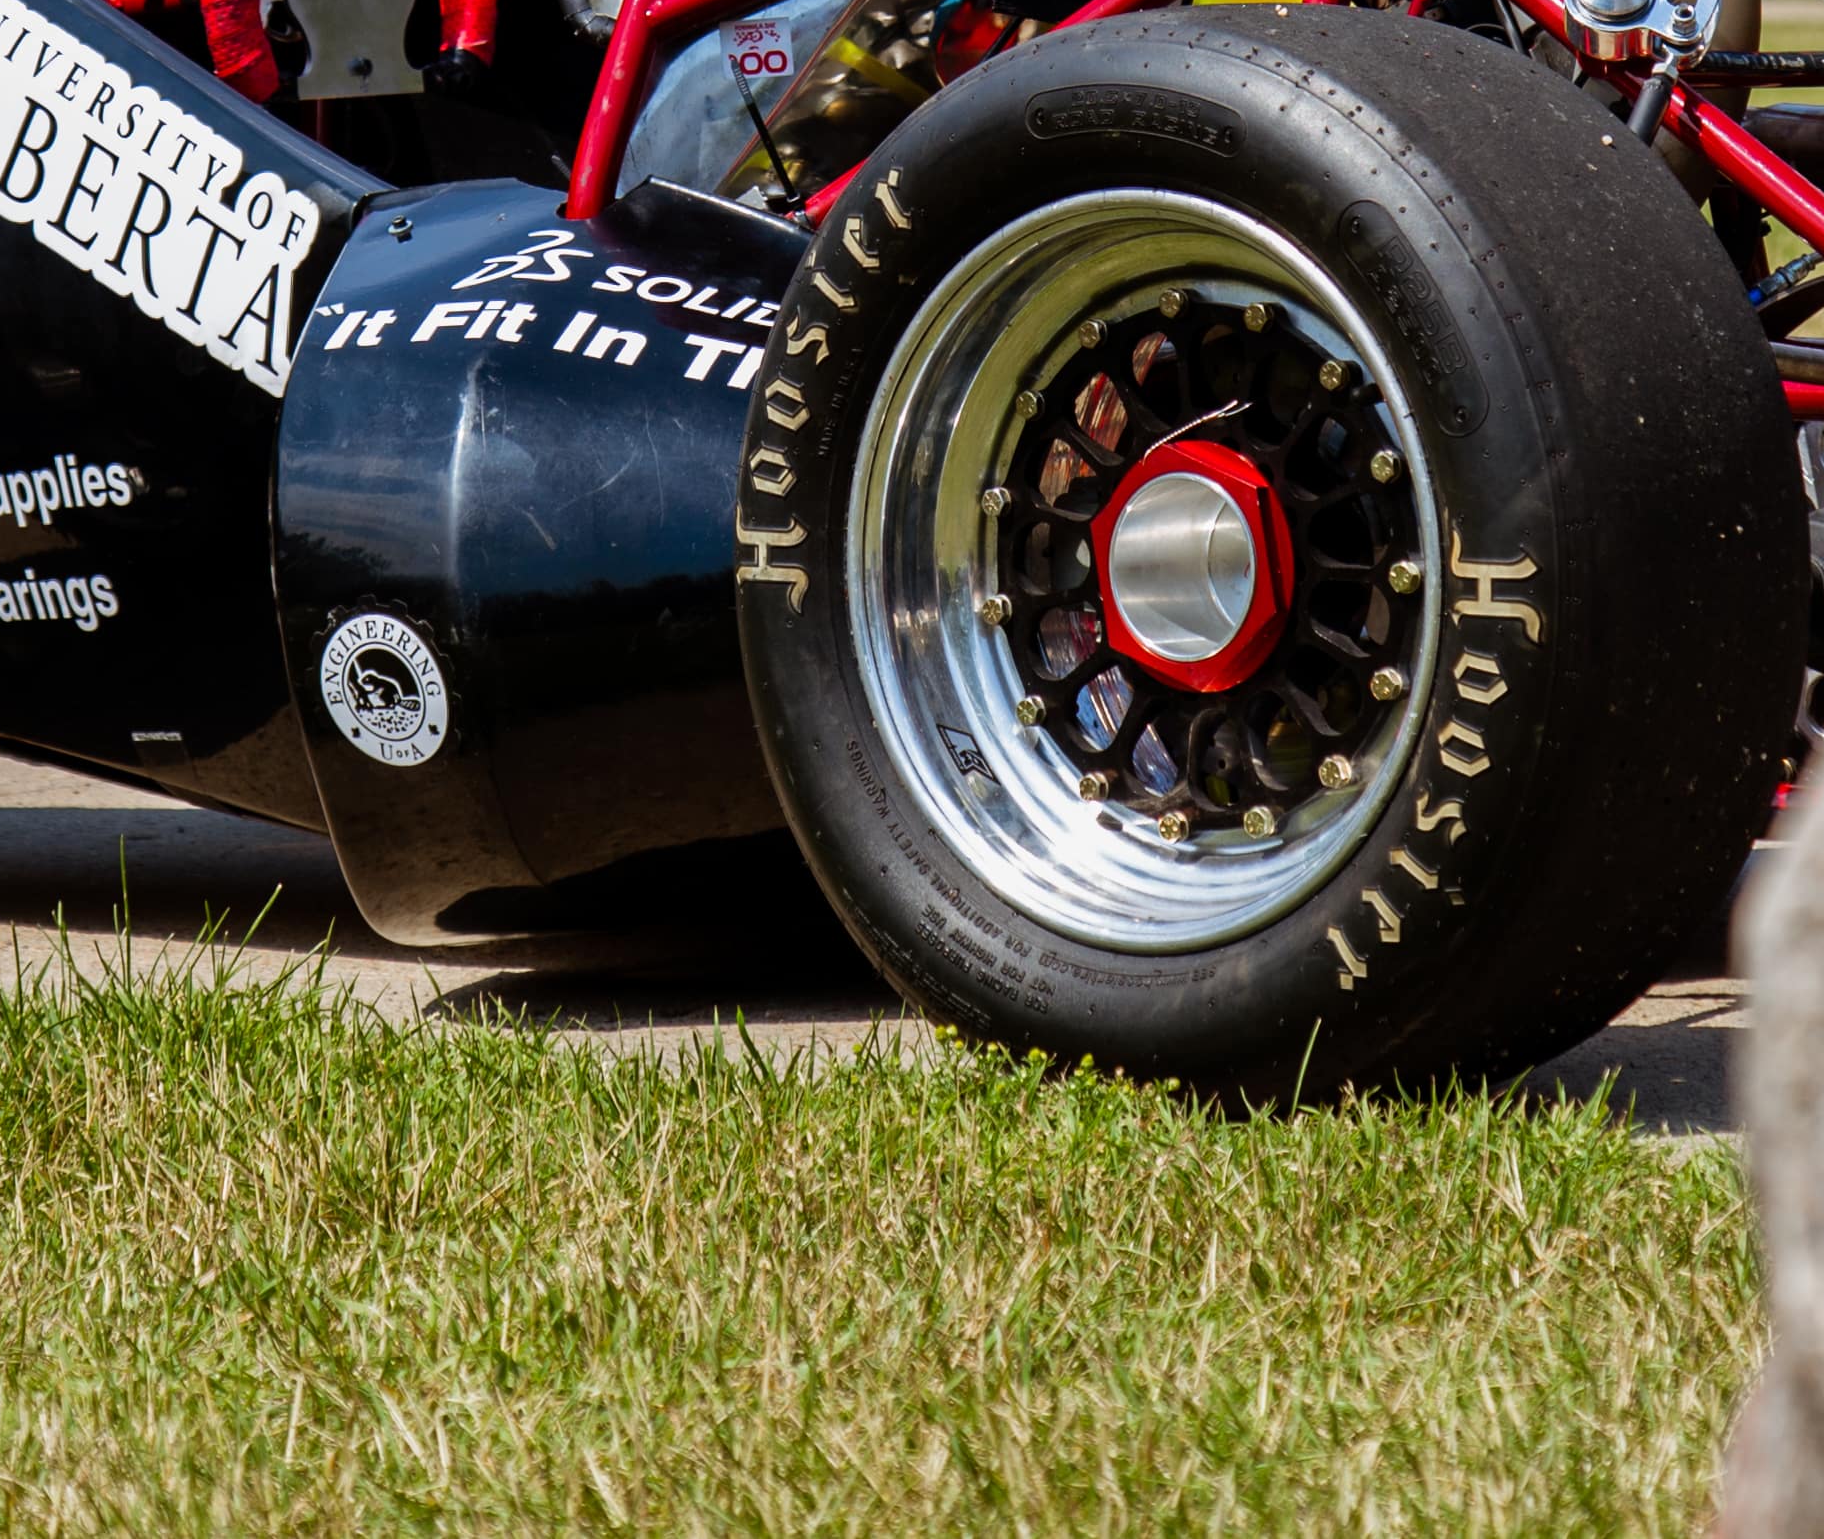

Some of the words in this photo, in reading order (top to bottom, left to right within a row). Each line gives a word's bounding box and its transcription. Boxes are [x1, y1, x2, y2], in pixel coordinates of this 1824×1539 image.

[728, 50, 788, 75] 00
[248, 193, 306, 251] OF
[410, 299, 538, 343] Fit
[553, 313, 649, 366] In
[737, 166, 914, 616] Hoosier
[325, 620, 441, 705] ENGINEERING
[845, 739, 889, 820] WARNINGS
[1328, 527, 1545, 992] Hoosier
[886, 821, 932, 877] SAFETY
